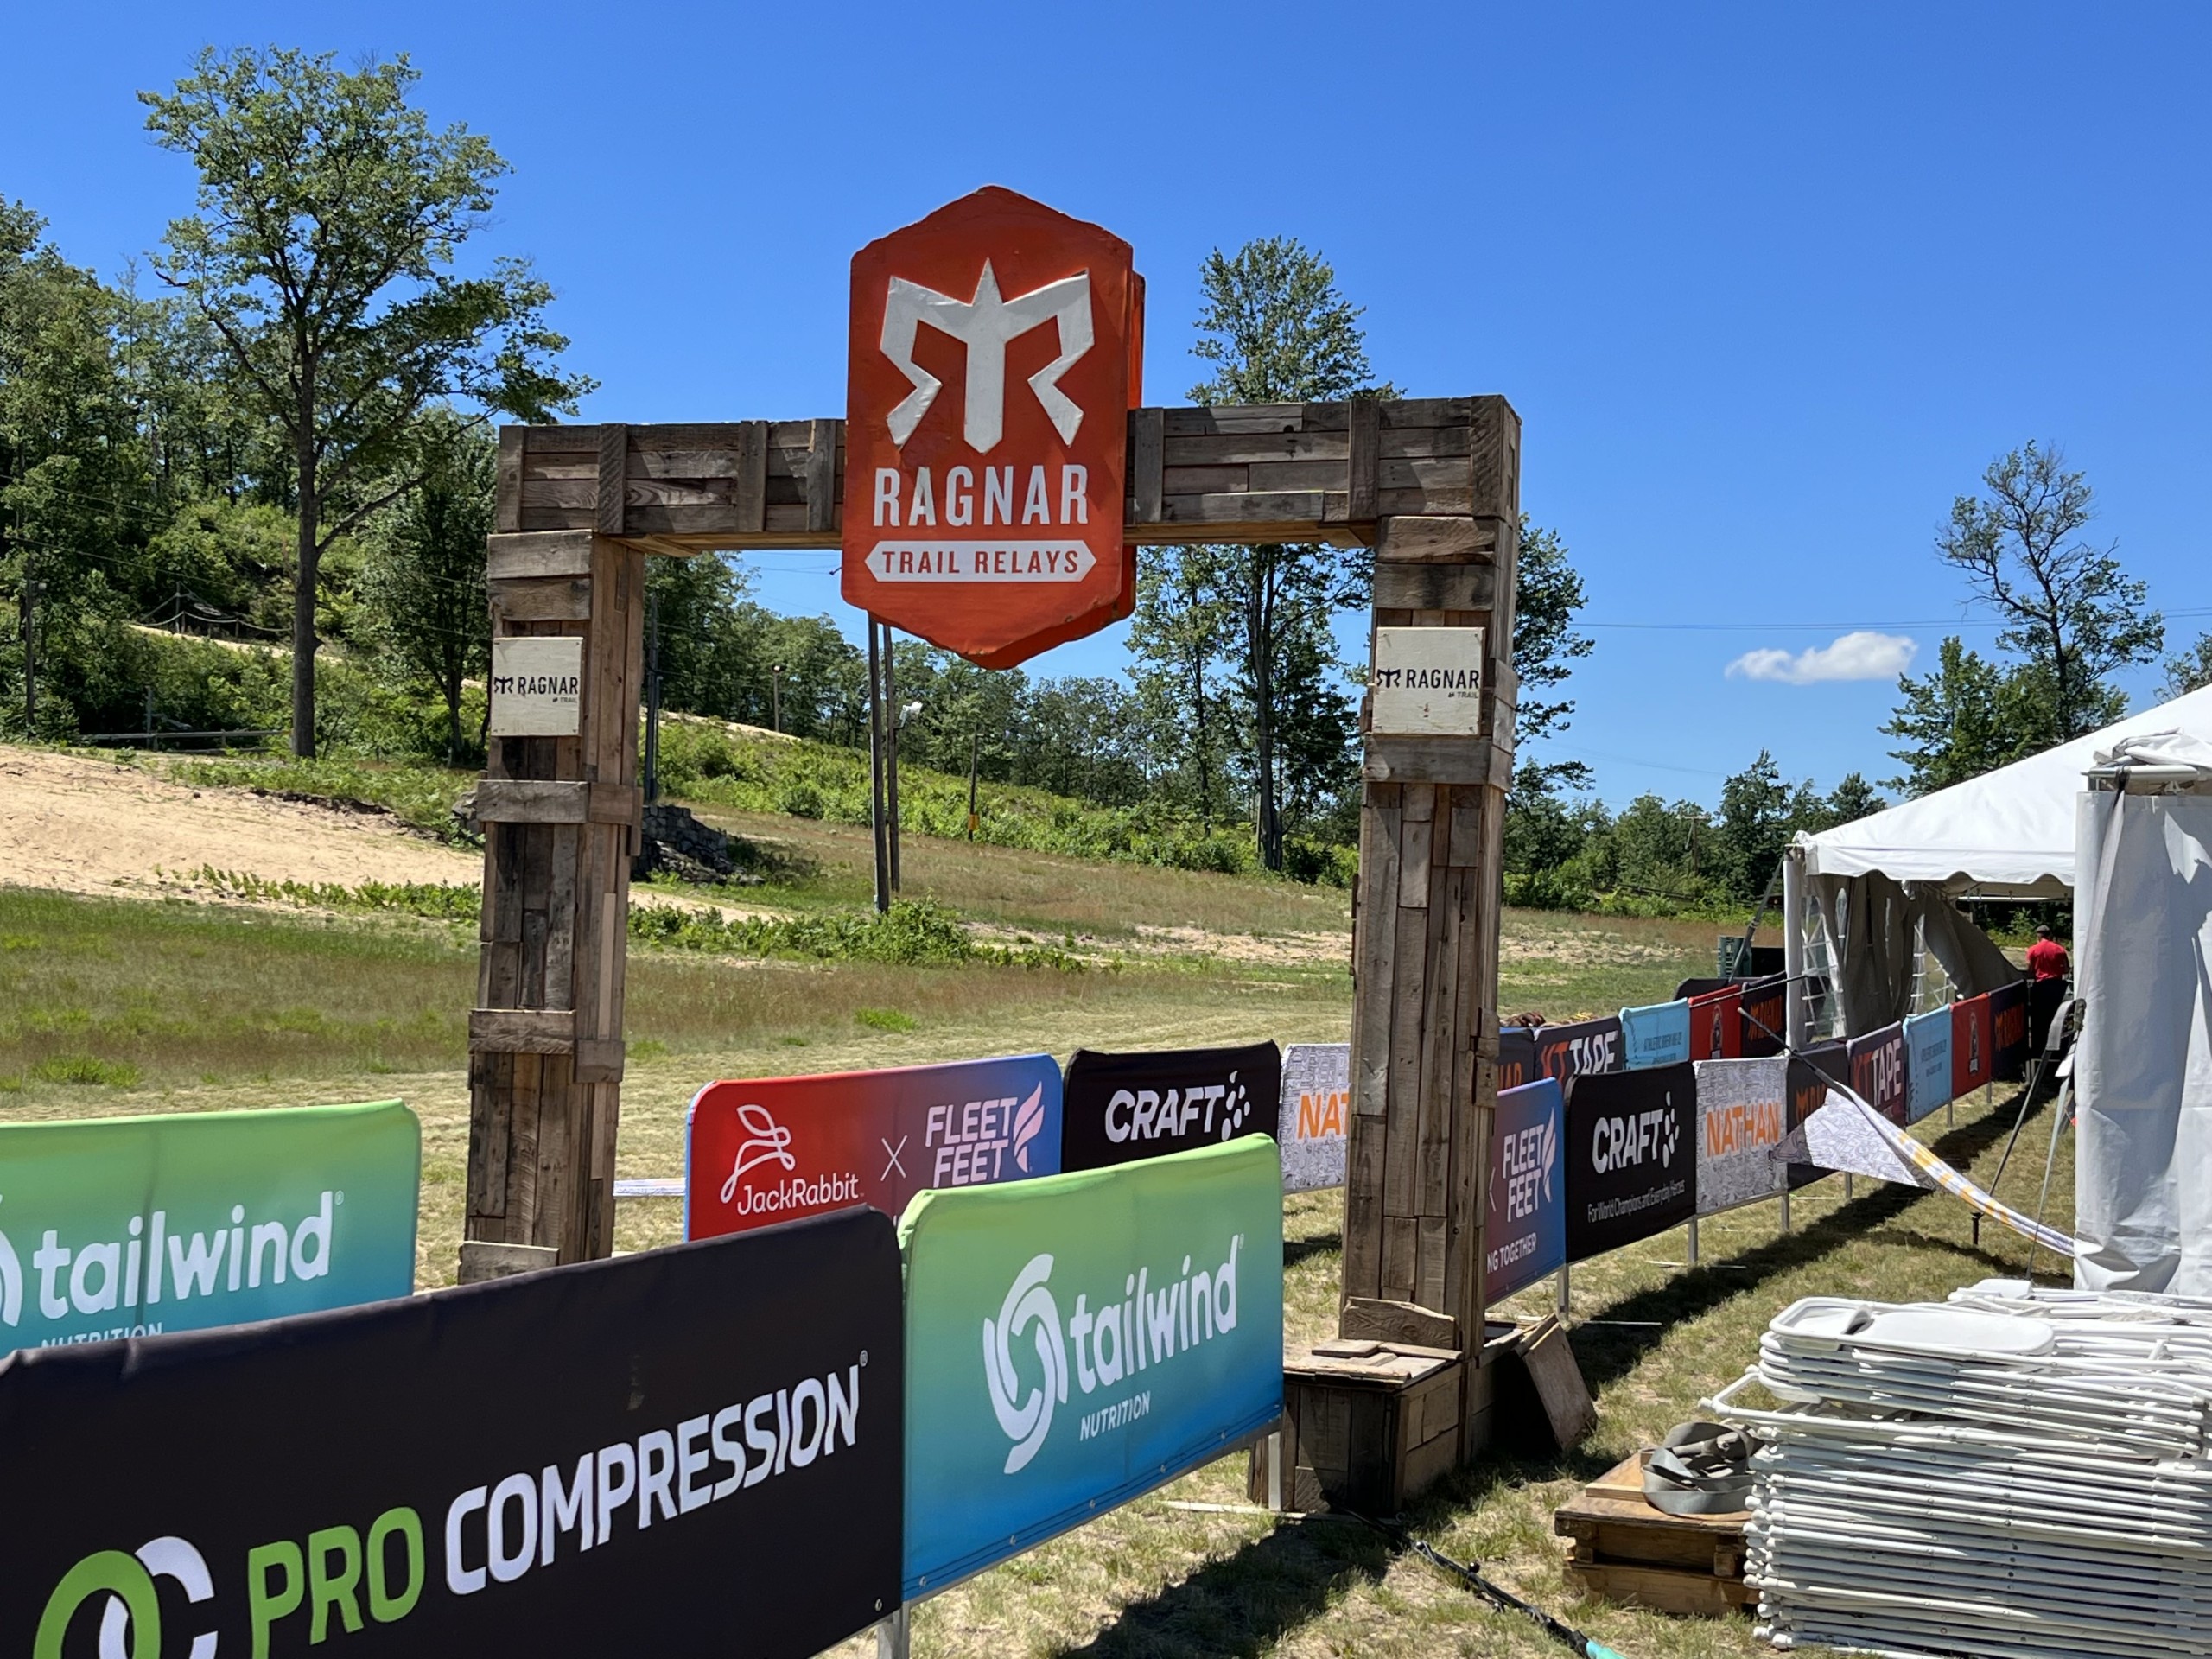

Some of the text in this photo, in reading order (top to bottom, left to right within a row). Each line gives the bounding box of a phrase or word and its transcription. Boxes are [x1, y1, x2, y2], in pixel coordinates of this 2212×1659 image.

[873, 464, 1089, 527] RAGNAR
[882, 550, 1079, 574] TRAIL RELAYS
[518, 676, 578, 695] RAGNAR
[1406, 669, 1479, 689] RAGNAR
[1871, 1037, 1901, 1106] TAPE
[925, 1096, 1018, 1147] FLEET
[1105, 1084, 1225, 1143] CRAFT
[1706, 1102, 1780, 1158] NATHAN
[933, 1139, 1009, 1188] FEET
[1502, 1123, 1545, 1179] FLEET
[1592, 1109, 1664, 1174] CRAFT
[737, 1173, 859, 1216] JackRabbit
[1507, 1168, 1542, 1223] FEET
[33, 1191, 333, 1320] tailwind
[1499, 1232, 1536, 1268] TOGETHER
[1070, 1234, 1239, 1394] tailwind
[1080, 1390, 1150, 1441] NUTRITION
[249, 1364, 860, 1659] PRO COMPRESSION
